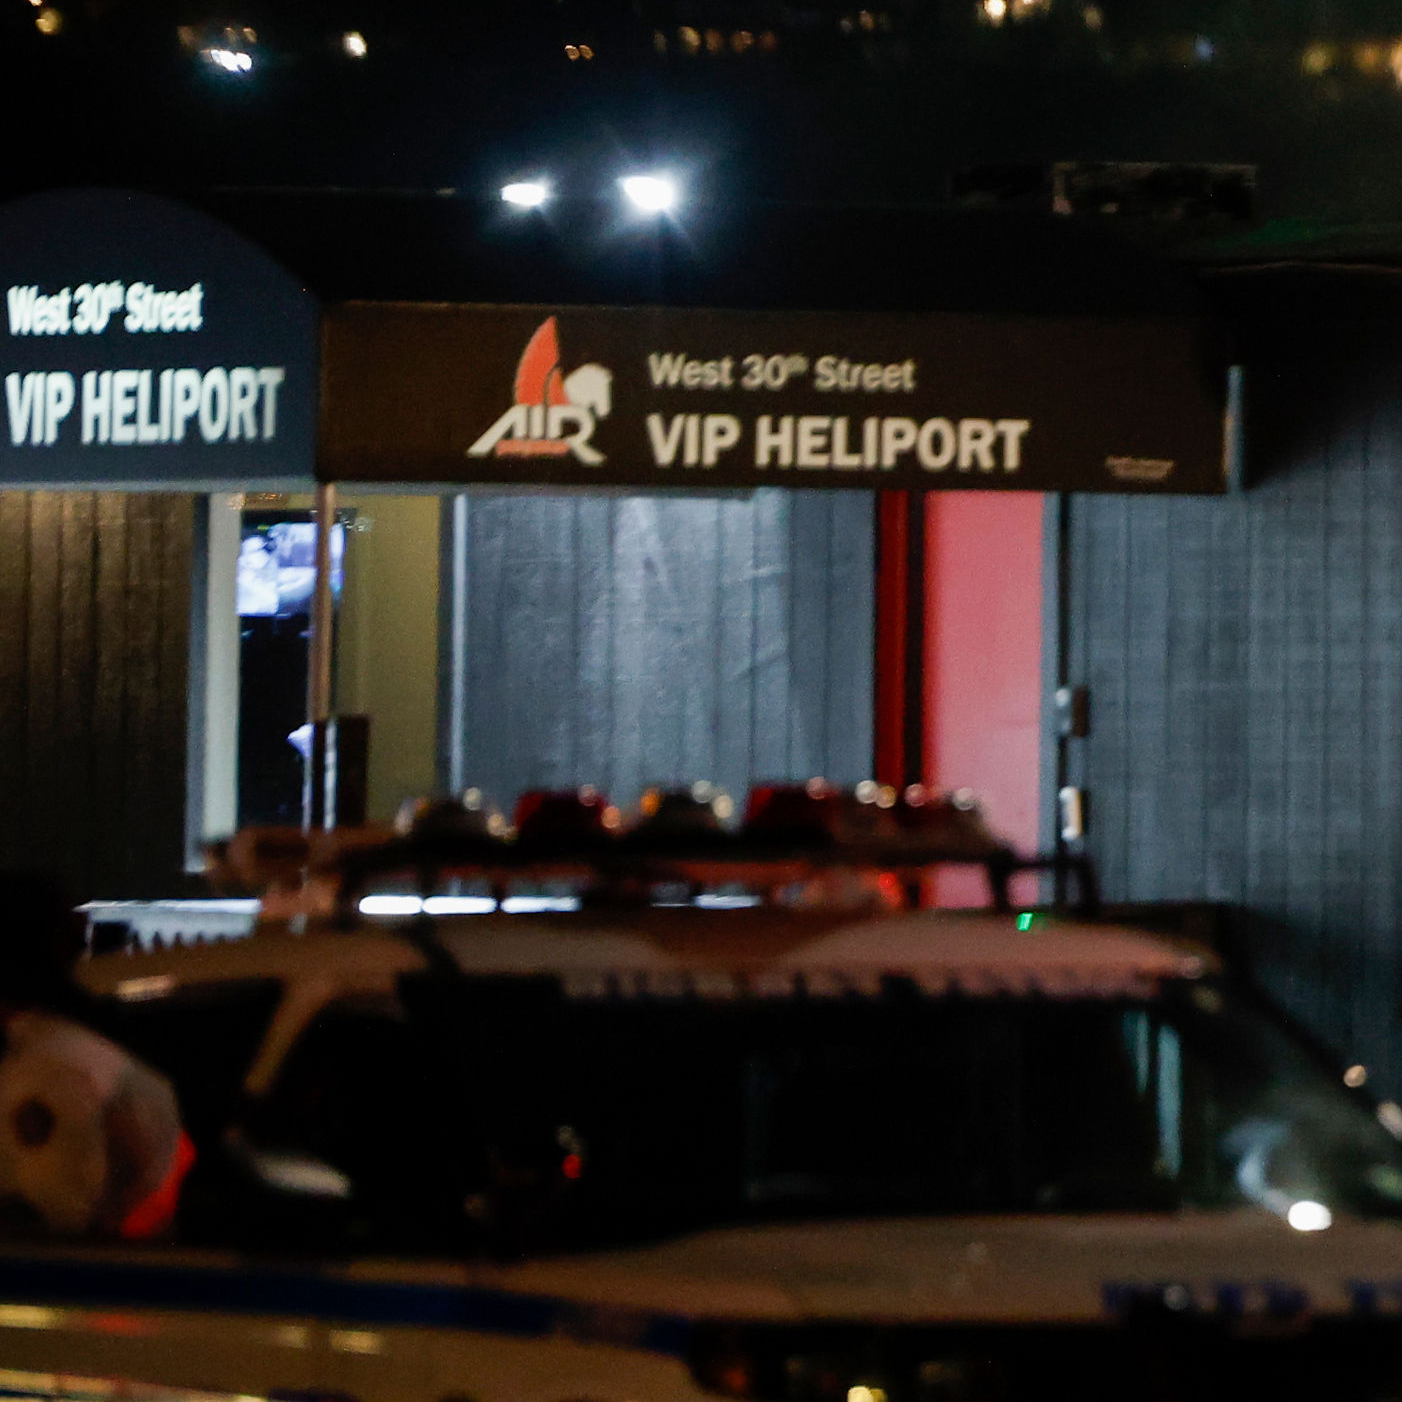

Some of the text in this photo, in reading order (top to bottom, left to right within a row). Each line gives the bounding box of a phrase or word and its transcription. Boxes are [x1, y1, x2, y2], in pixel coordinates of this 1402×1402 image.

[7, 285, 71, 335] West
[124, 281, 205, 333] Street
[647, 353, 734, 388] West
[814, 355, 916, 392] Street
[5, 366, 285, 446] VIP HELIPORT
[646, 413, 1029, 473] VIP HELIPORT
